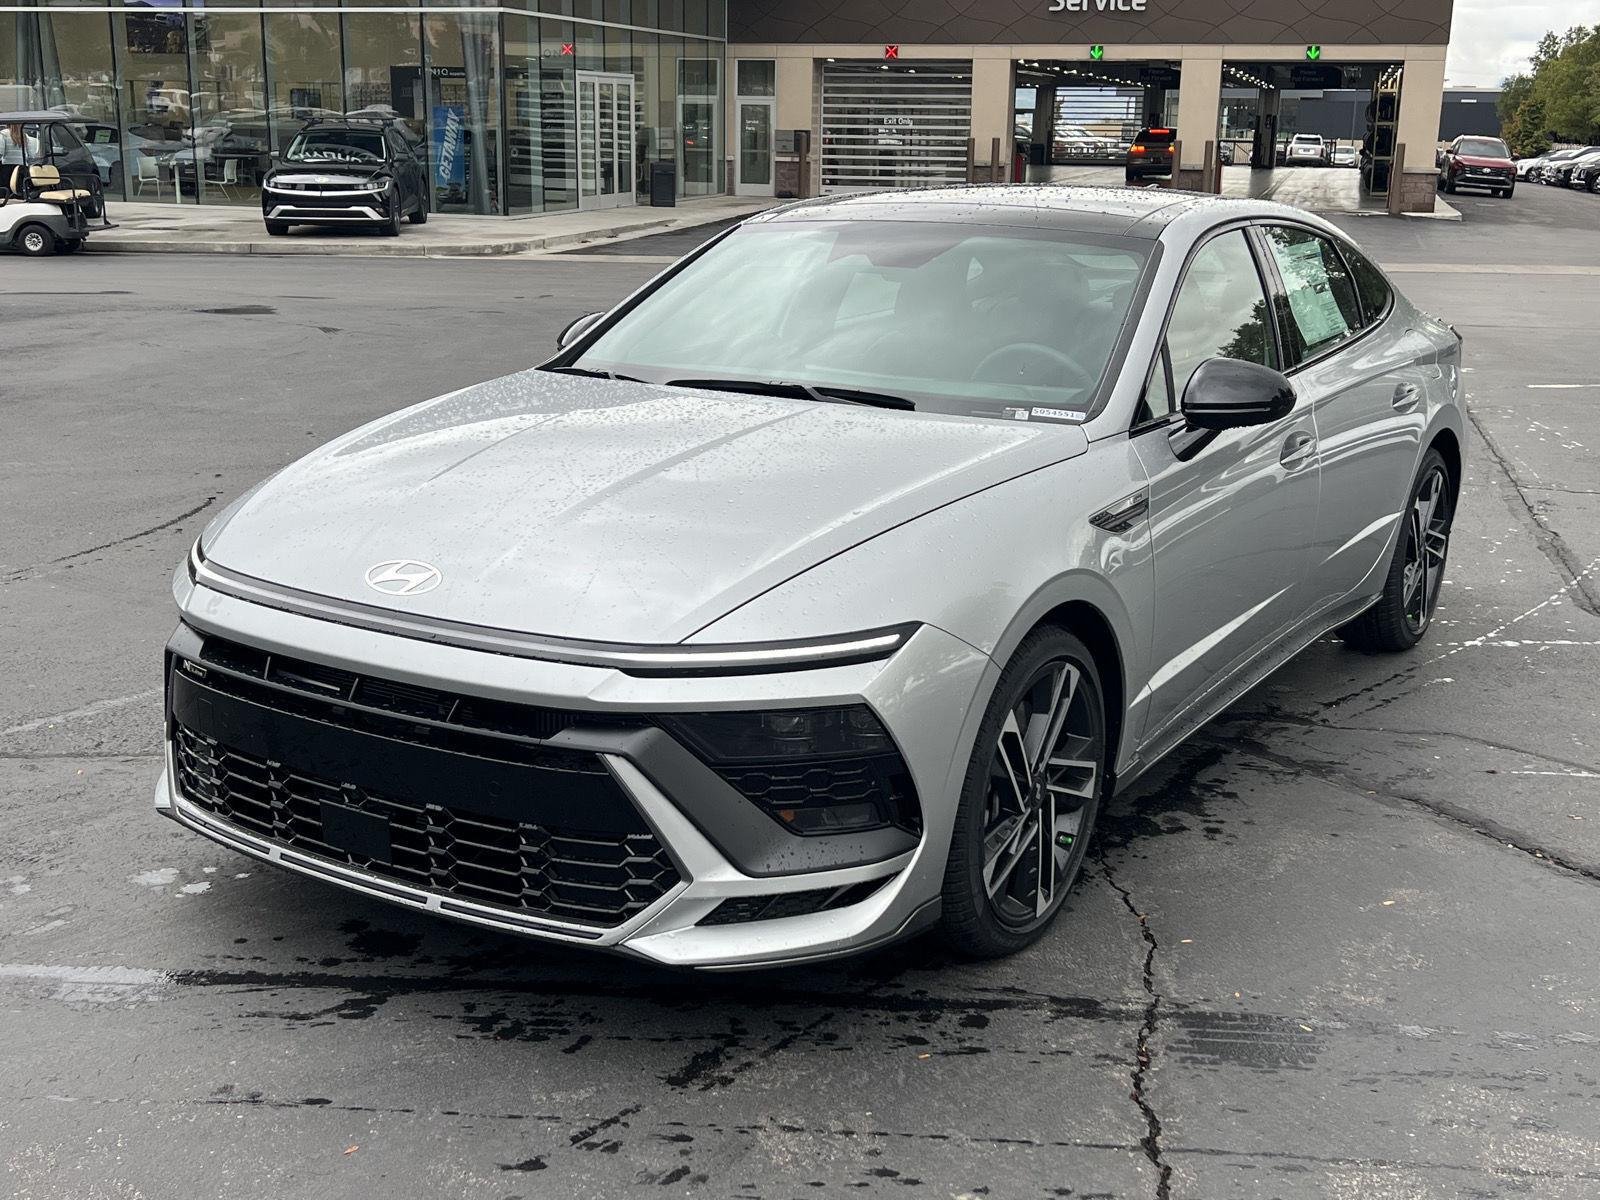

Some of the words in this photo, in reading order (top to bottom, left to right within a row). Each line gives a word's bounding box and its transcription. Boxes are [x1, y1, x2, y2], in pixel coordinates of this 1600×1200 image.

[883, 117, 897, 125] Exit
[898, 117, 914, 127] Only
[439, 107, 460, 180] GETAWAY
